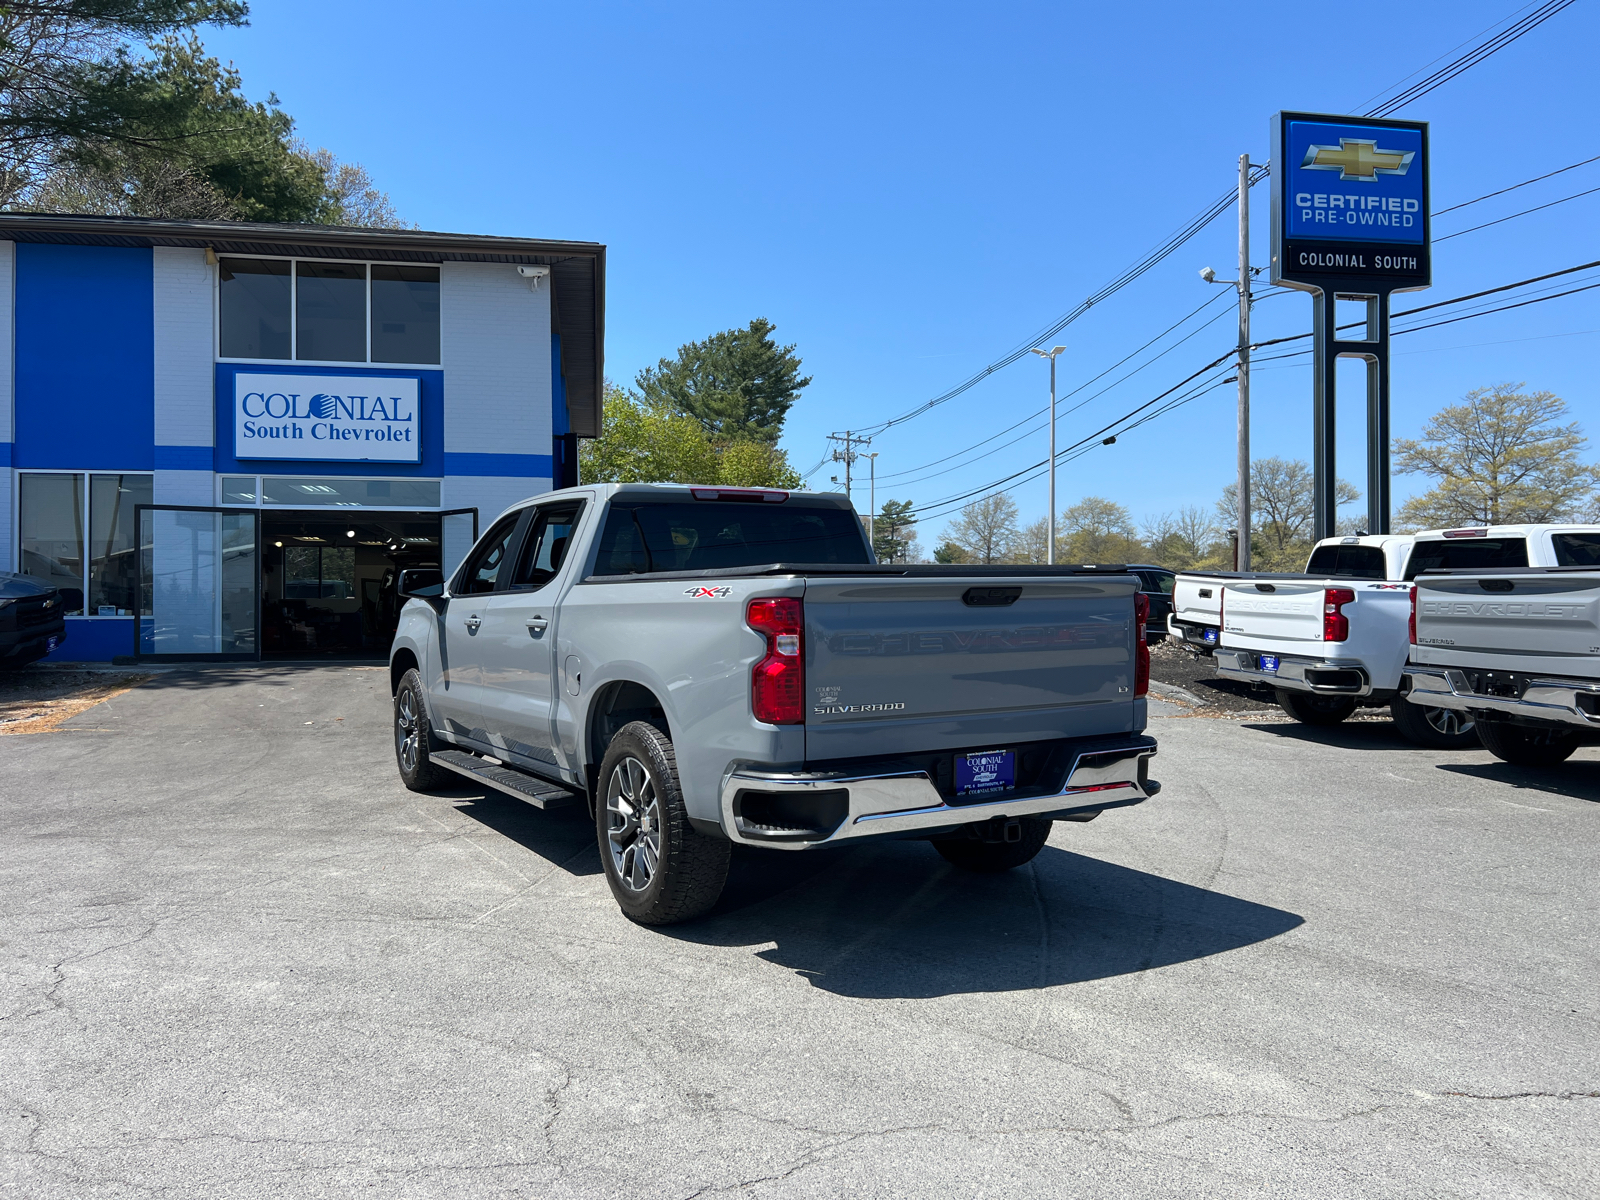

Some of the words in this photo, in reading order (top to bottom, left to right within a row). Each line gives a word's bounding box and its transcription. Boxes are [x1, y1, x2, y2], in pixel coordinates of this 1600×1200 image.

[1295, 192, 1419, 213] CERTIFIED
[1302, 209, 1414, 227] PRE-OWNED
[1299, 252, 1366, 268] COLONIAL
[1374, 255, 1417, 270] SOUTH
[242, 392, 412, 422] COLONIAL
[243, 421, 303, 439] South
[311, 422, 412, 442] Chevrolet
[1226, 599, 1313, 613] CHEVROLET
[1423, 602, 1586, 618] CHEVROLET
[841, 625, 1126, 652] CHEVROLET
[813, 702, 905, 715] SILVERADO
[967, 756, 1003, 767] COLONIAL
[972, 764, 998, 774] SOUTH
